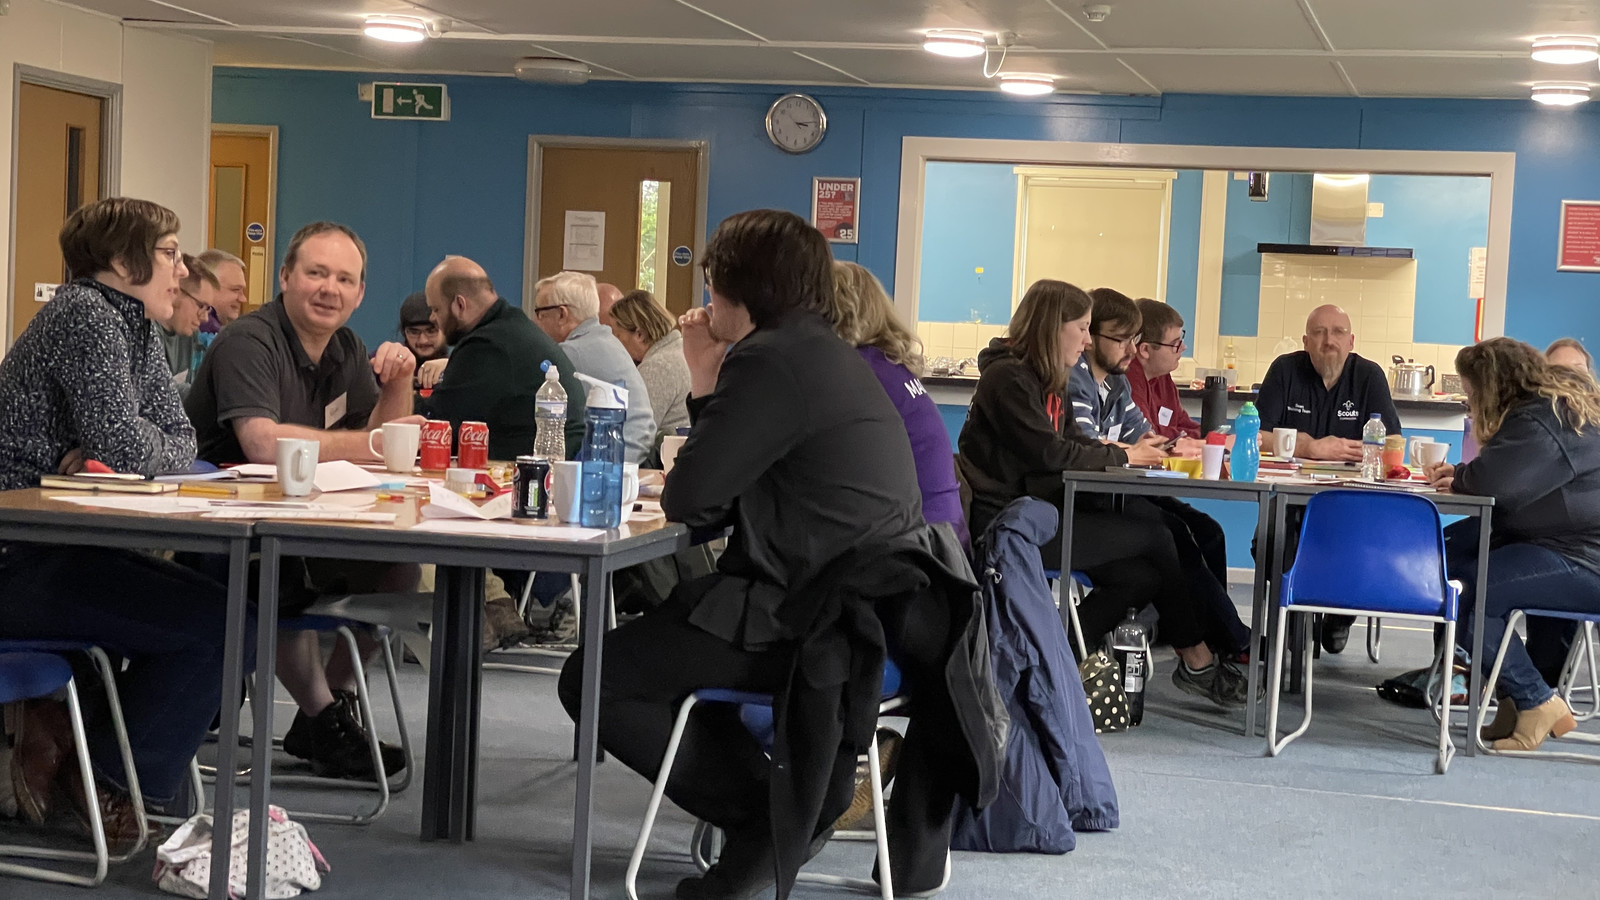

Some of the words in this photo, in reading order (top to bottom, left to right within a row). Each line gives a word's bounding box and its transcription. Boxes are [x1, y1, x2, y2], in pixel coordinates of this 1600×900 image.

[818, 182, 854, 191] UNDER
[818, 190, 836, 199] 25?
[839, 229, 853, 239] 25
[1337, 409, 1359, 417] Scouts
